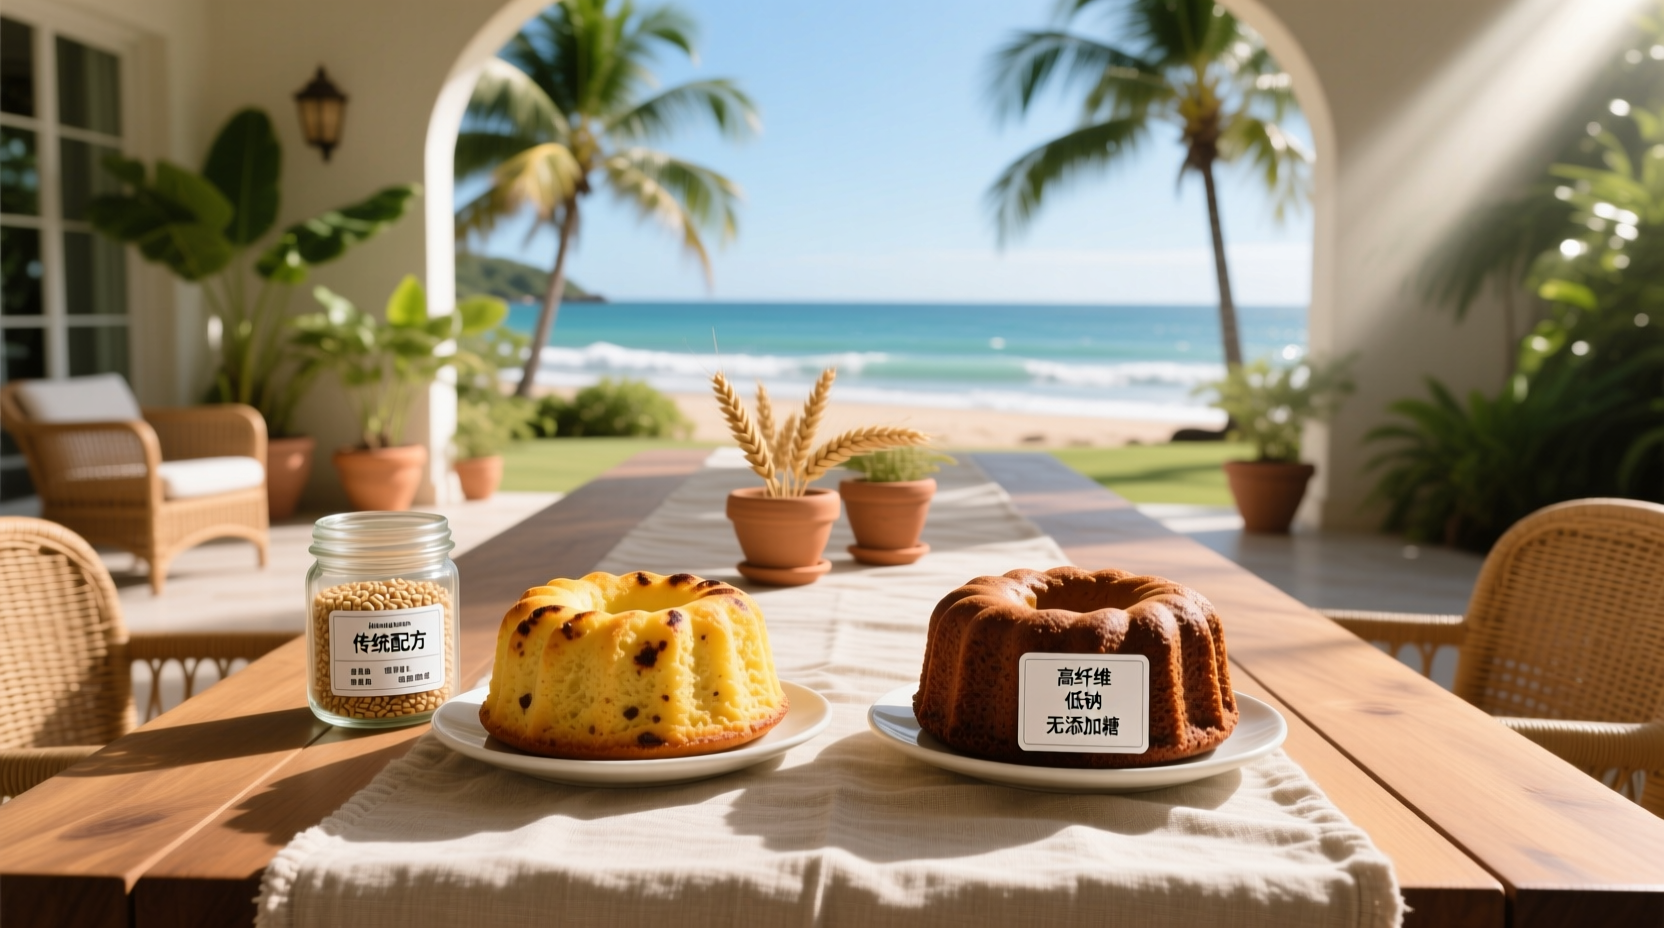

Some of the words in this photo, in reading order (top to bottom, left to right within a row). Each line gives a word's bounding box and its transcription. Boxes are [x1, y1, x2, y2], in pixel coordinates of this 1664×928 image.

[353, 630, 427, 655] 传统配方
[1057, 666, 1112, 687] 高纤维
[1064, 690, 1102, 710] 低钠
[1046, 715, 1120, 737] 无添加糖
